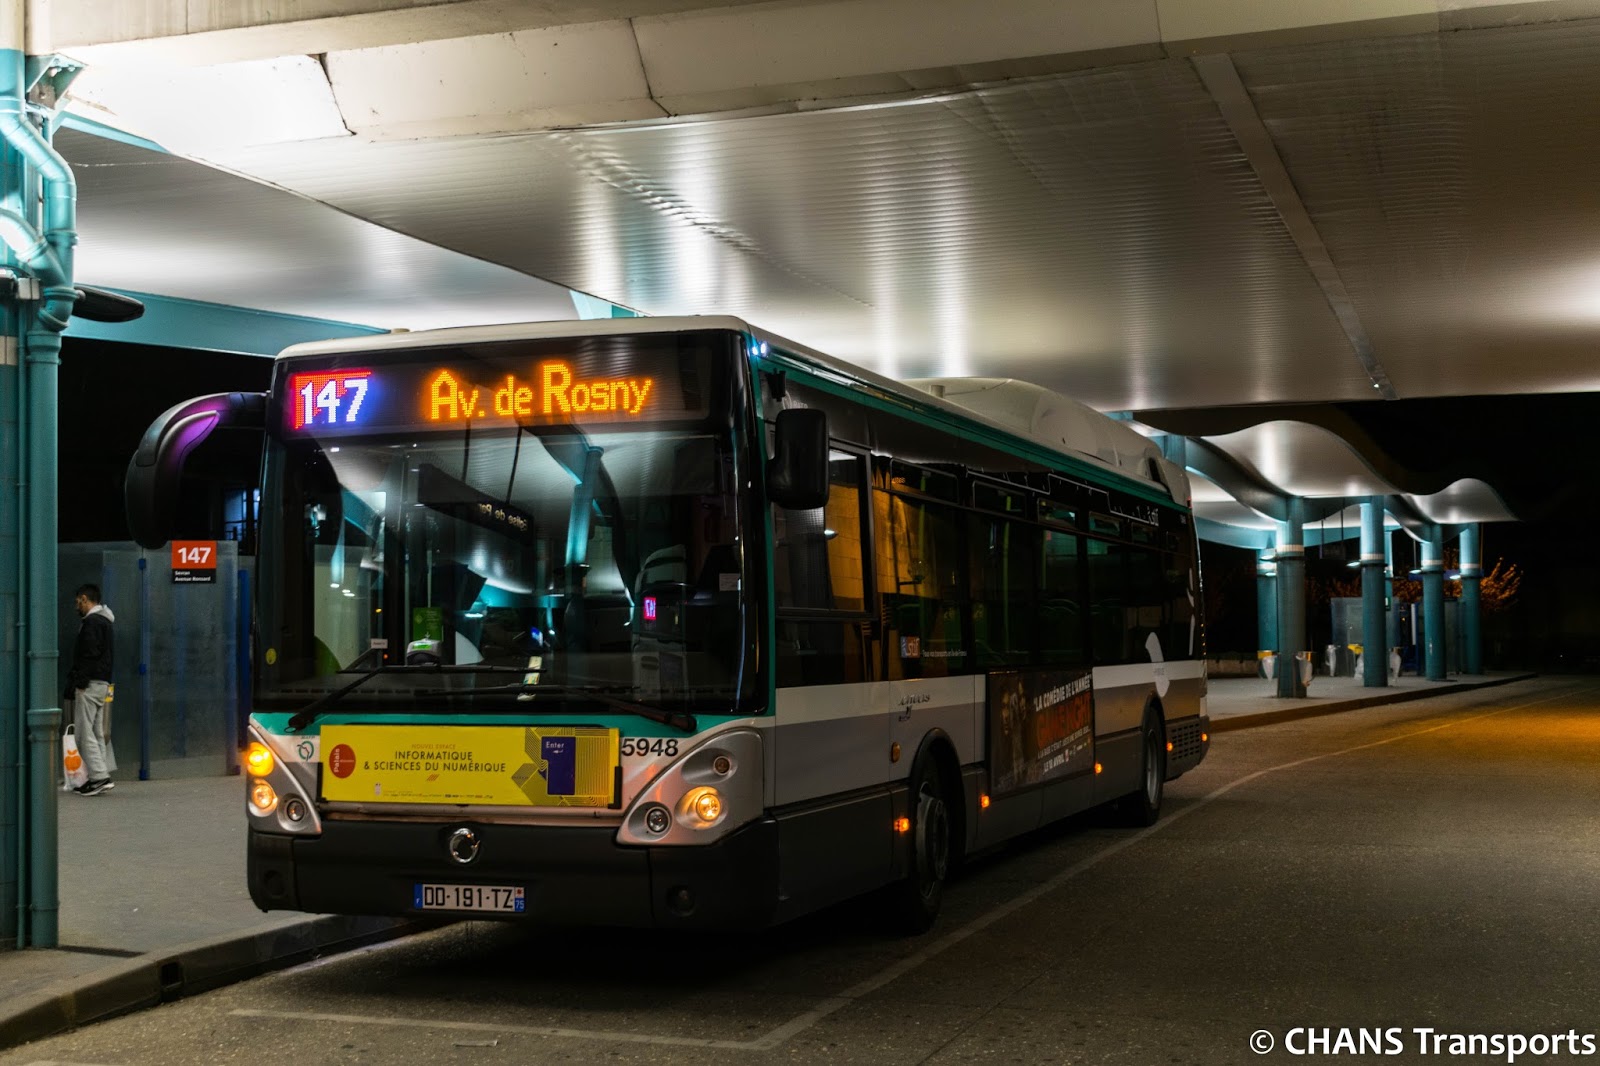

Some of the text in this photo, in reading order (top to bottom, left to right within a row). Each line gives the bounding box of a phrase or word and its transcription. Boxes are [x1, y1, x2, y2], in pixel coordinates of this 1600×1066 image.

[300, 378, 369, 424] 147
[431, 363, 652, 420] Av. de Rosny
[178, 547, 211, 564] 147
[545, 740, 565, 749] Enter
[621, 737, 679, 757] 5948
[333, 748, 341, 773] Palais
[363, 759, 507, 772] & SCIENCES DU NUMÉRIQUE
[394, 750, 473, 761] INFORMATIQUE
[424, 886, 514, 909] DD-191-TZ
[515, 899, 525, 910] 75
